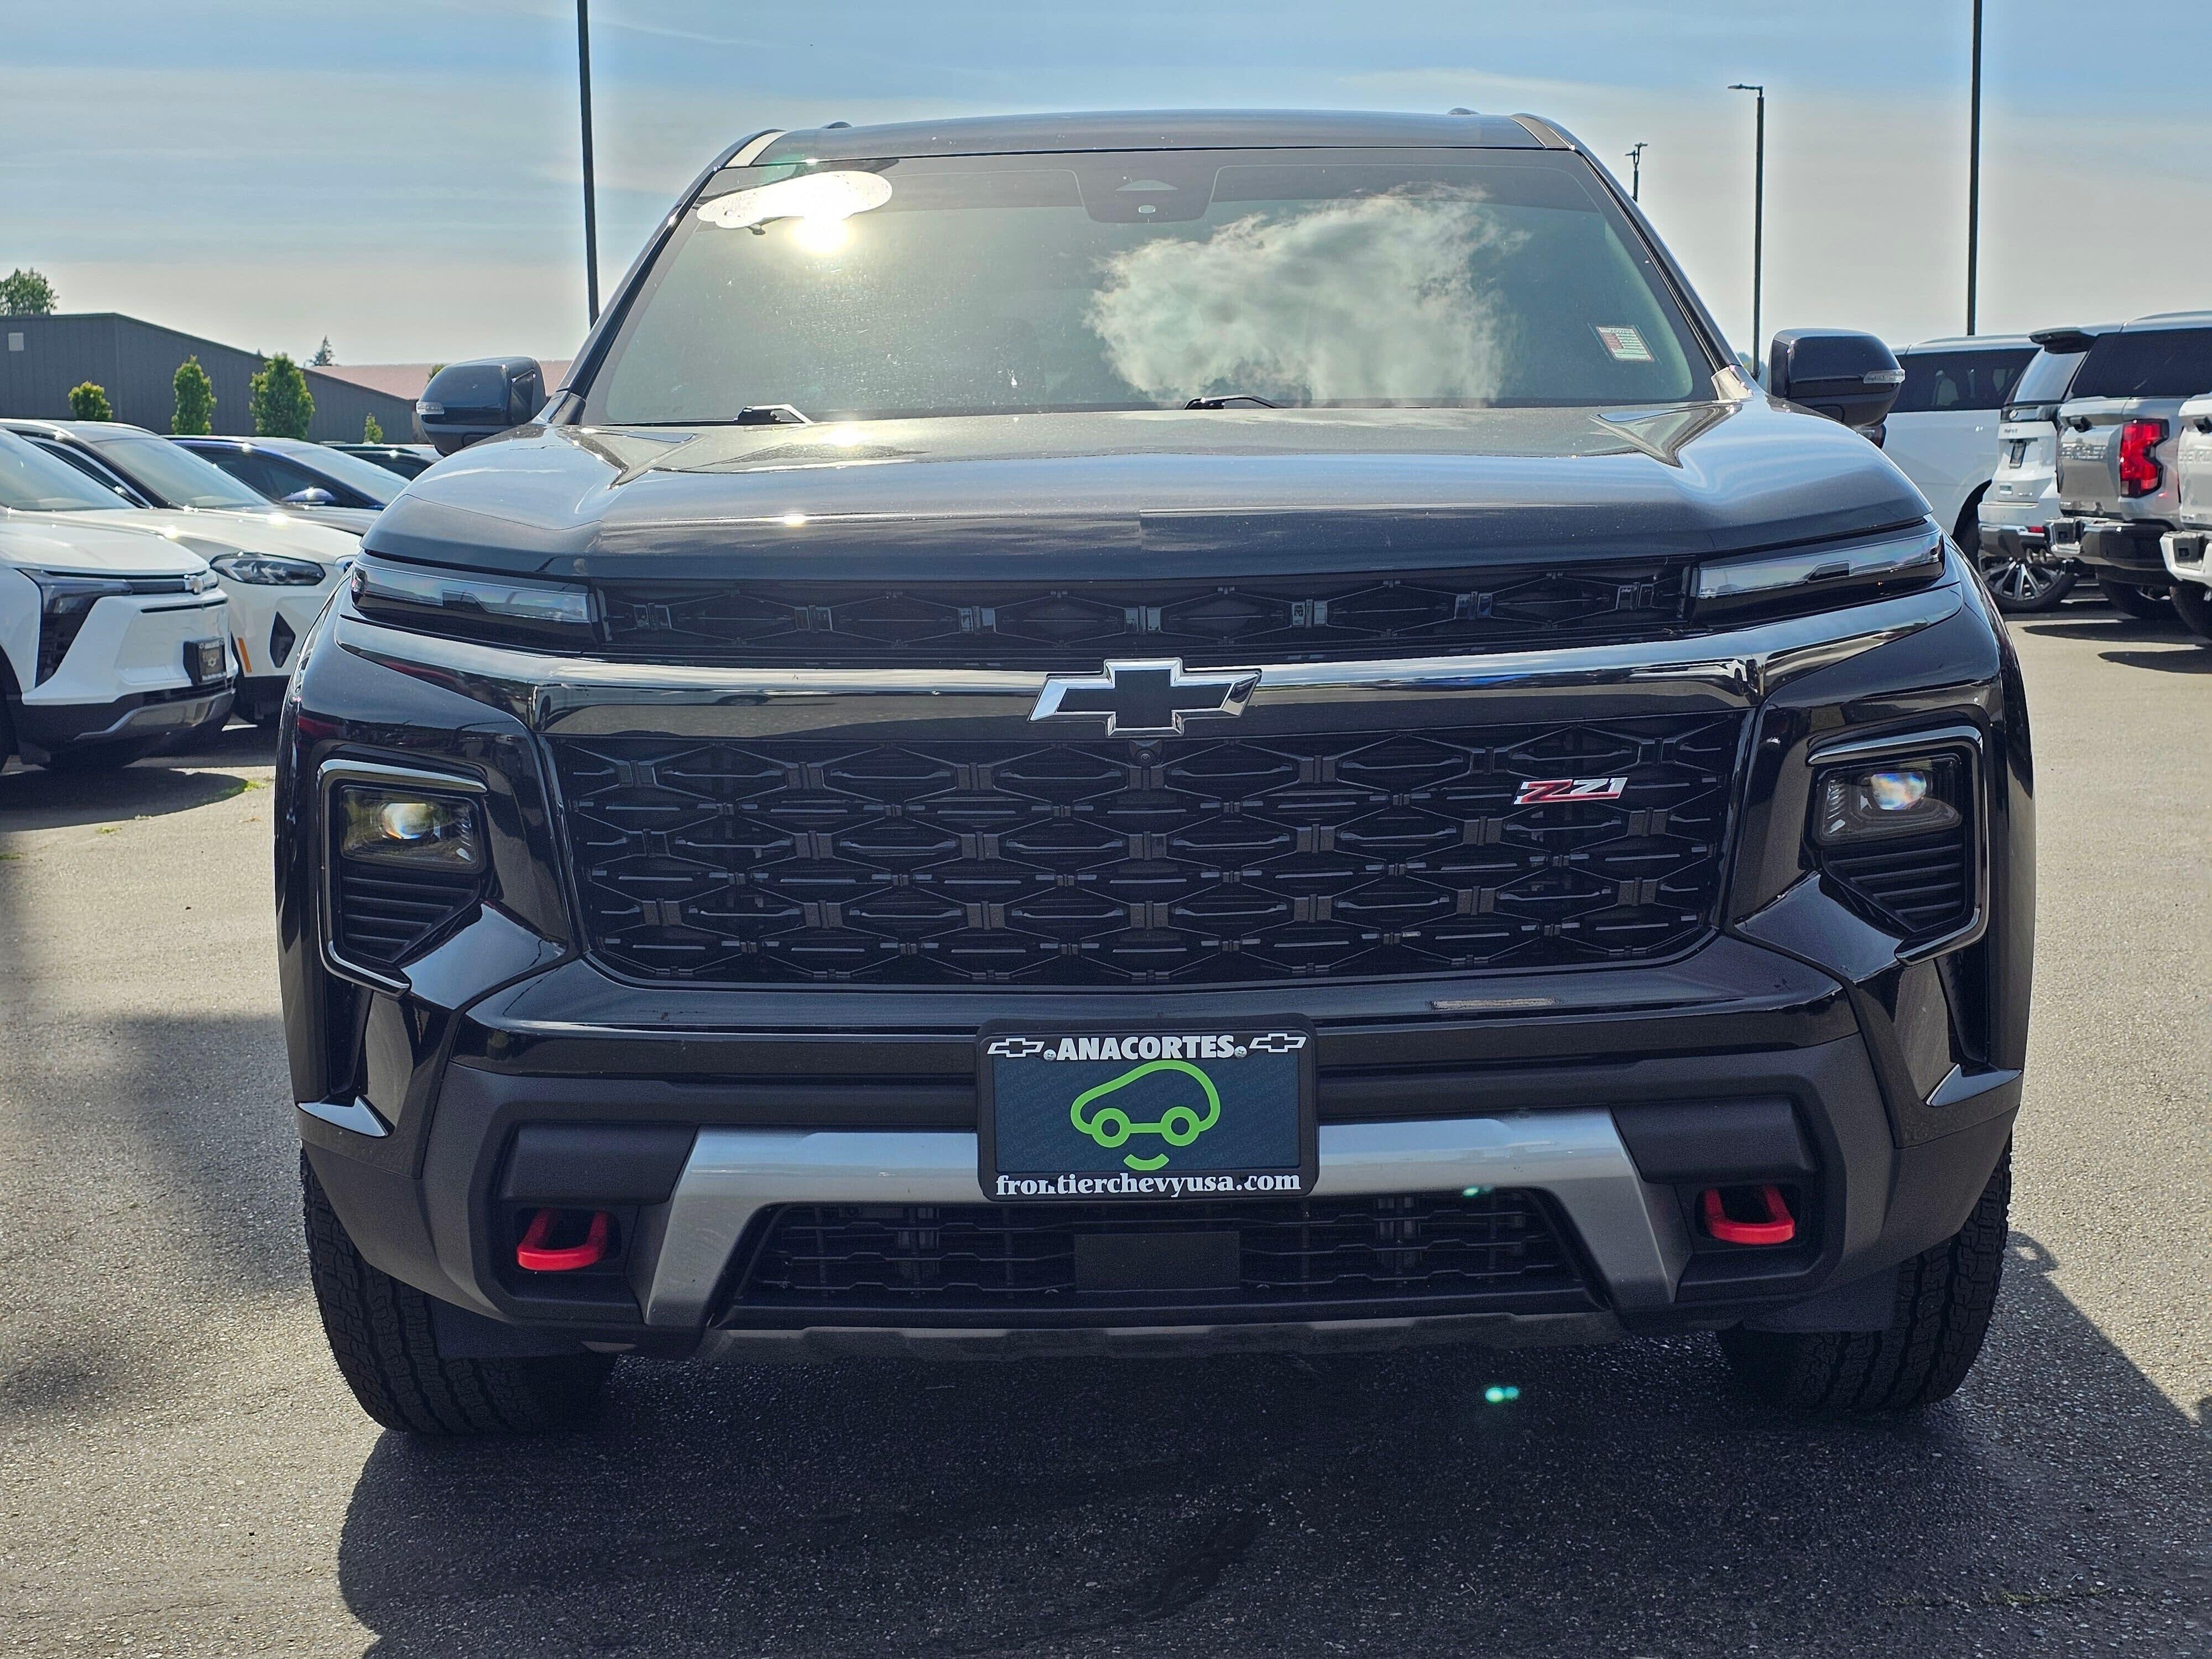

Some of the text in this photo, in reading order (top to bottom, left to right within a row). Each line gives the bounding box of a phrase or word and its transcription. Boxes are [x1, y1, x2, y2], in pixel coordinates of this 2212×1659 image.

[1514, 778, 1628, 805] Z71
[1056, 1035, 1235, 1061] ANACORTES
[996, 1173, 1302, 1198] frontierchevyusa.com
